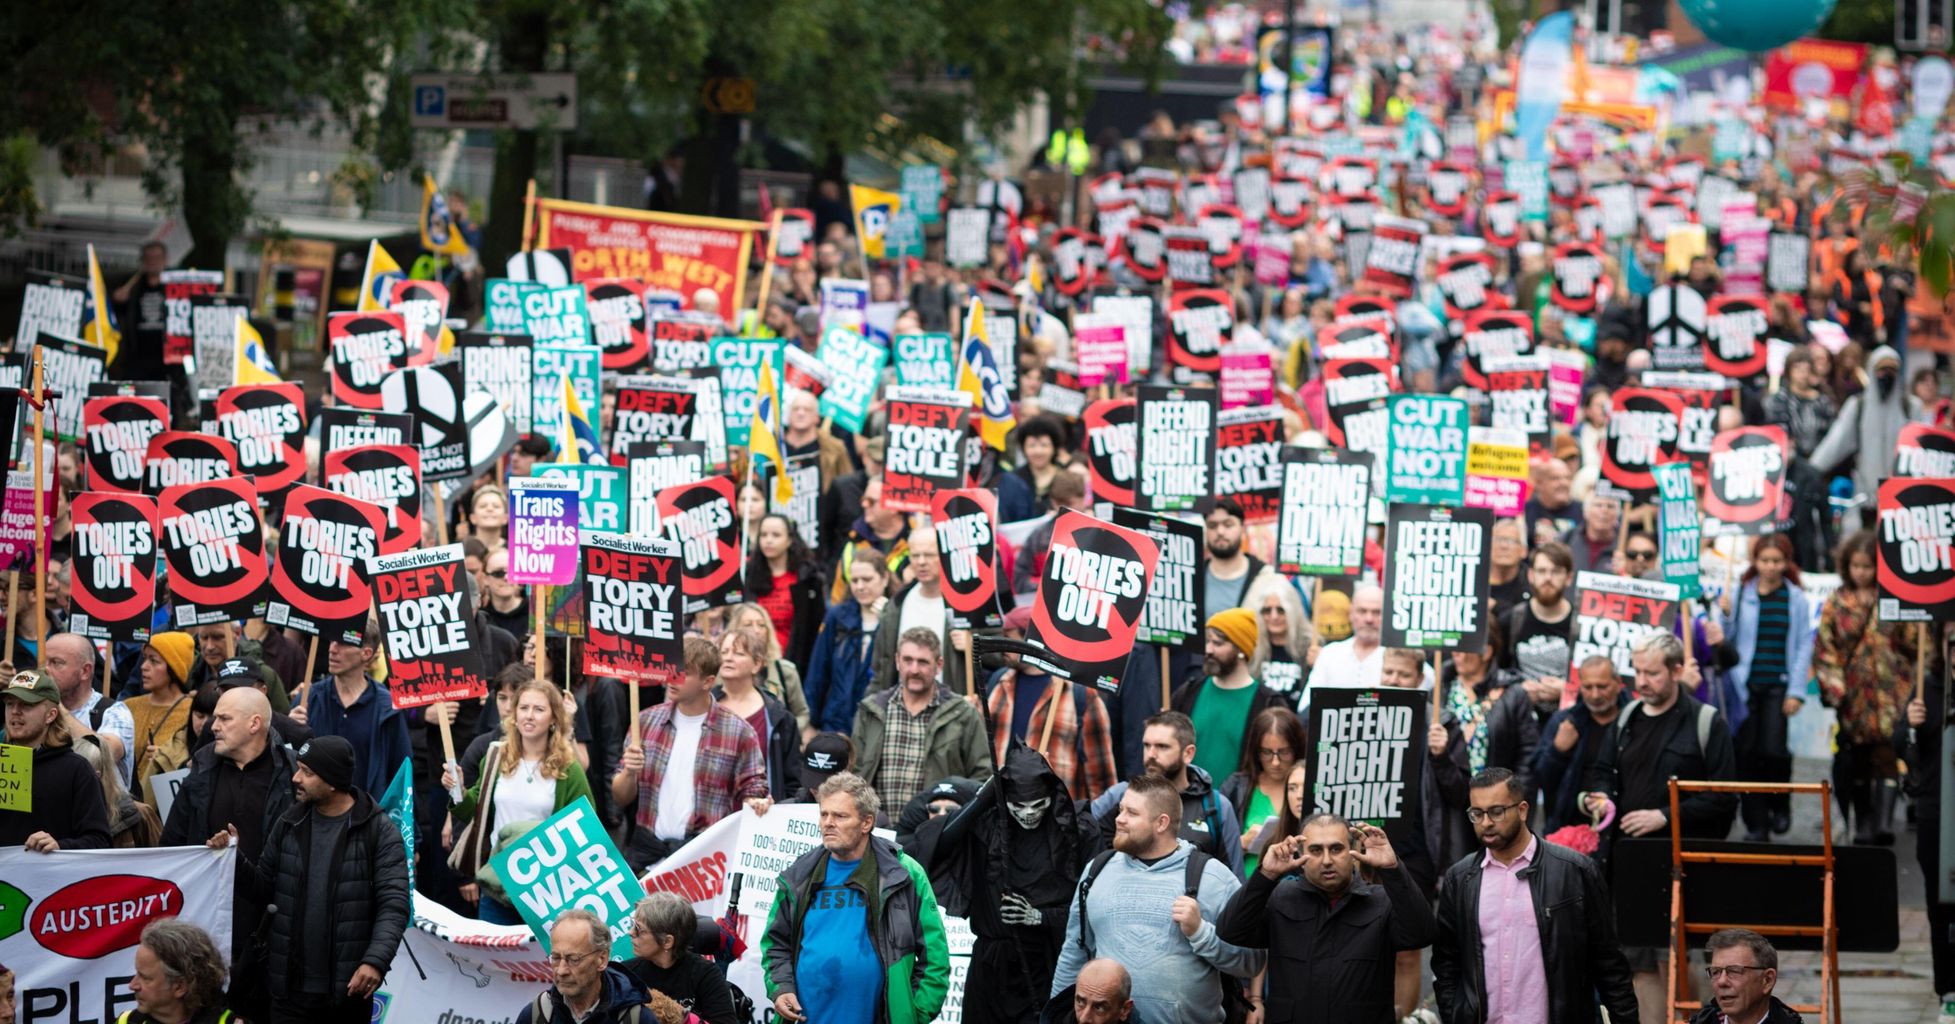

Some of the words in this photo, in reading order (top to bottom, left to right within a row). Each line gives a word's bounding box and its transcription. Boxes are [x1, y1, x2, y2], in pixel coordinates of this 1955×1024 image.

[525, 288, 581, 317] CUT
[526, 313, 585, 341] WAR
[332, 329, 405, 364] TORIES
[464, 346, 531, 383] BRING
[533, 349, 595, 376] CUT
[715, 341, 780, 367] CUT
[898, 337, 949, 360] CUT
[898, 362, 951, 384] WAR
[618, 390, 691, 414] DEFY
[889, 401, 965, 428] DEFY
[1144, 400, 1210, 429] DEFEND
[1394, 398, 1464, 425] CUT
[87, 418, 164, 455] TORIES
[220, 403, 300, 441] TORIES
[329, 424, 402, 451] DEFEND
[615, 410, 690, 440] TORY
[887, 423, 963, 455] TORY
[1088, 422, 1137, 457] TOR
[1393, 424, 1464, 451] WAR
[240, 434, 285, 468] OUT
[421, 455, 465, 473] APONS
[886, 446, 961, 479] RULE
[1142, 427, 1210, 466] RIGHT
[1392, 449, 1464, 477] NOT
[1897, 444, 1955, 478] TORIE
[110, 449, 147, 481] OU
[147, 456, 232, 488] TORIES
[328, 465, 416, 500] TORIES
[631, 454, 701, 499] BRING
[1141, 464, 1208, 497] STRIKE
[1286, 461, 1370, 506] BRING
[1, 509, 51, 528] fuges
[512, 490, 565, 517] Trans
[662, 497, 732, 543] TORIES
[75, 520, 152, 556] TORIES
[163, 500, 256, 549] TORIES
[286, 514, 377, 561] TORIES
[514, 518, 577, 551] Rights
[936, 511, 992, 554] TORIES
[1281, 503, 1366, 548] DOWN
[1400, 520, 1483, 556] DEFEND
[189, 536, 242, 578] OUT
[377, 555, 418, 571] Socialist
[417, 550, 452, 565] Worker
[514, 545, 556, 574] Now
[591, 535, 632, 551] Socialist
[632, 541, 668, 555] Worker
[684, 531, 719, 570] OUT
[1665, 529, 1699, 561] NOT
[1900, 537, 1953, 574] OUT
[93, 554, 135, 590] OUT
[301, 550, 354, 590] OUT
[587, 548, 673, 584] DEFY
[949, 545, 981, 583] OUT
[1051, 542, 1146, 601] TORIES
[1150, 561, 1196, 602] GHT
[1396, 553, 1480, 597] RIGHT
[376, 563, 458, 603] DEFY
[586, 574, 676, 612] TORY
[379, 591, 463, 631] TORY
[589, 601, 675, 640] RULE
[1056, 583, 1118, 630] OUT
[1138, 595, 1198, 636] TRIKE
[1392, 594, 1478, 632] STRIKE
[1580, 590, 1669, 626] DEFY
[386, 620, 470, 661] RULE
[445, 688, 470, 699] occupy
[1320, 705, 1413, 743] DEFEND
[1316, 740, 1409, 785] RIGHT
[1313, 782, 1405, 820] STRIKE
[506, 806, 588, 885] CUT
[740, 852, 752, 867] TO
[752, 834, 778, 851] 100%
[518, 843, 619, 920] WAR
[641, 851, 728, 903] AIRNESS
[744, 874, 756, 889] IN
[40, 887, 173, 935] AUSTERITY
